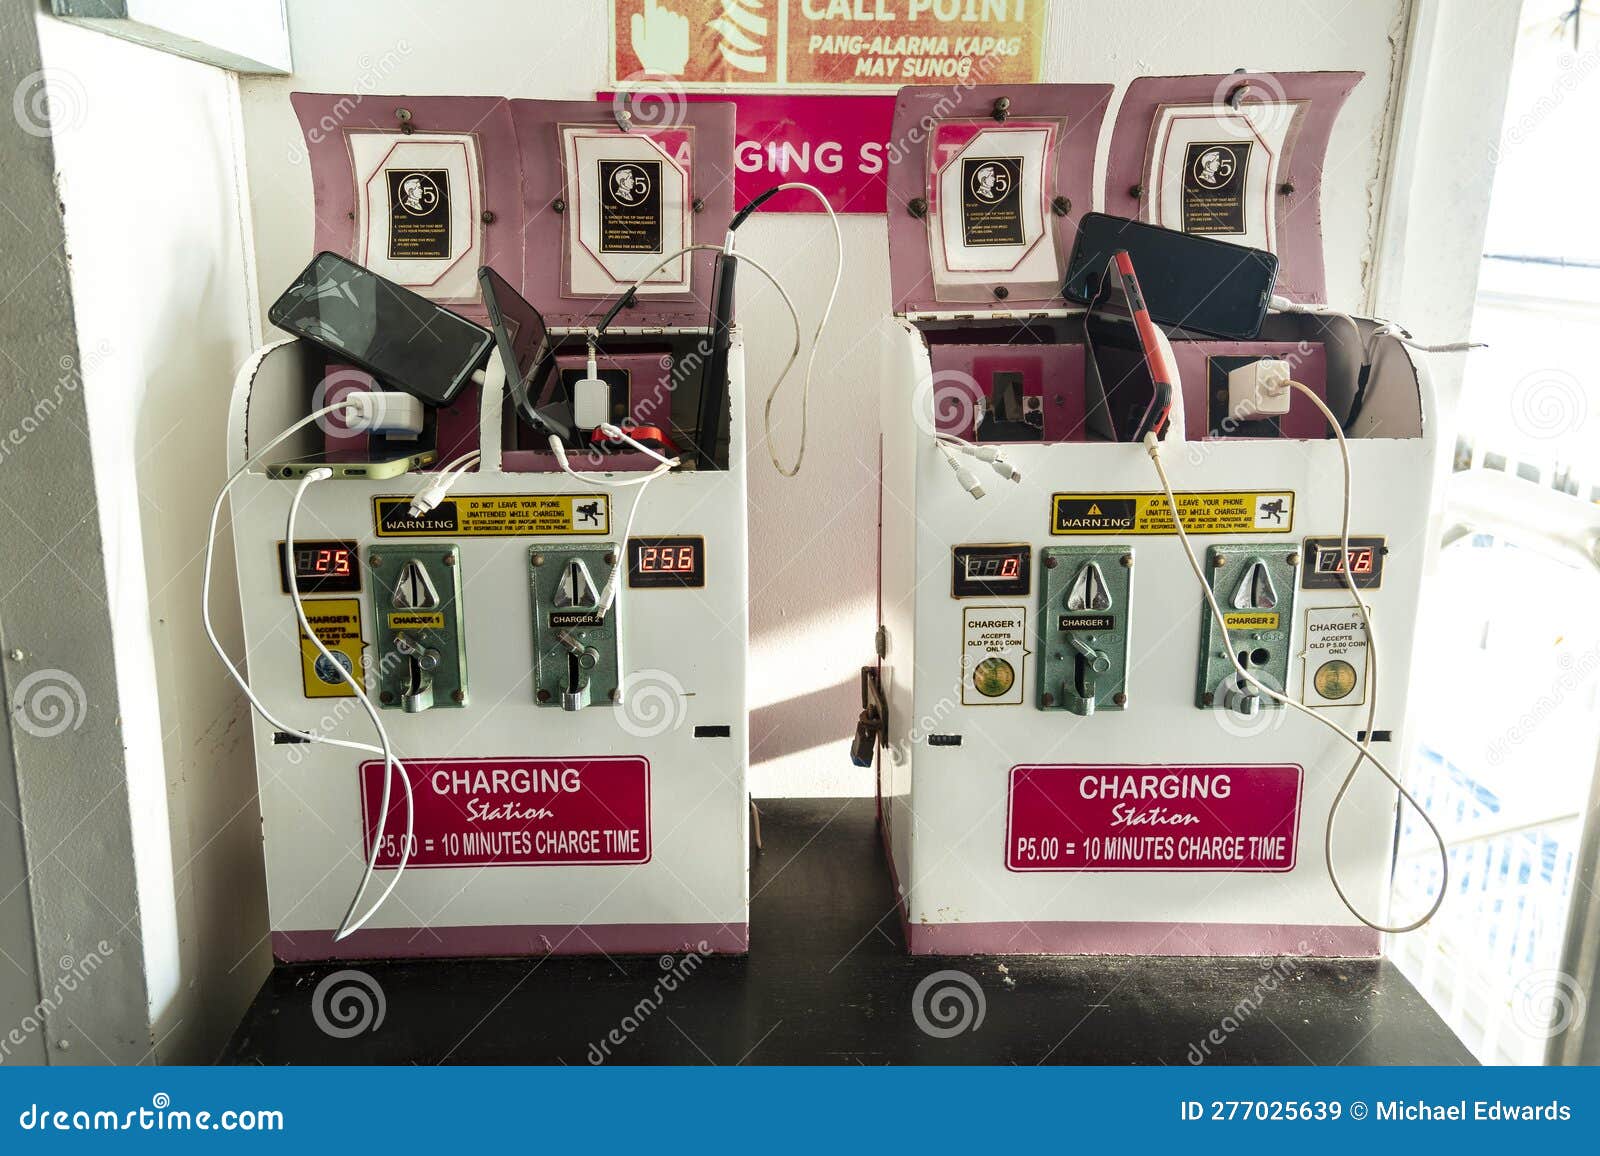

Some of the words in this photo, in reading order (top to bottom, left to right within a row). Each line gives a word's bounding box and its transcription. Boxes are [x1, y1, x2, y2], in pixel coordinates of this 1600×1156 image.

[801, 0, 896, 21] CALL
[908, 0, 1026, 22] POINT
[808, 35, 949, 56] PANG-ALARMA
[954, 36, 1022, 56] KAPAG
[855, 58, 899, 77] MAY
[902, 57, 972, 77] SUNOG
[1219, 159, 1232, 176] 5
[635, 177, 647, 194] 5
[995, 175, 1007, 192] 5
[423, 187, 435, 204] 5
[386, 520, 454, 529] WARNING
[1062, 518, 1131, 527] WARNING
[642, 548, 692, 570] 256
[352, 615, 357, 623] 1
[435, 616, 440, 624] 1
[968, 620, 1014, 628] CHARGER
[1062, 619, 1103, 627] CHARGER
[1105, 619, 1110, 627] 1
[1227, 617, 1268, 625] CHARGER
[1309, 622, 1358, 631] CHARGER
[1359, 622, 1366, 630] 2
[431, 768, 581, 795] CHARGING
[1079, 774, 1231, 800] CHARGING
[466, 797, 554, 822] Station
[1110, 802, 1200, 827] Station
[441, 833, 459, 857] 10
[463, 831, 532, 856] MINUTES
[535, 829, 600, 855] CHARGE
[603, 829, 640, 853] TIME
[1017, 836, 1059, 861] P5.00
[1083, 836, 1100, 861] 10
[1104, 836, 1173, 861] MINUTES
[1178, 836, 1244, 861] CHARGE
[1249, 836, 1286, 860] TIME
